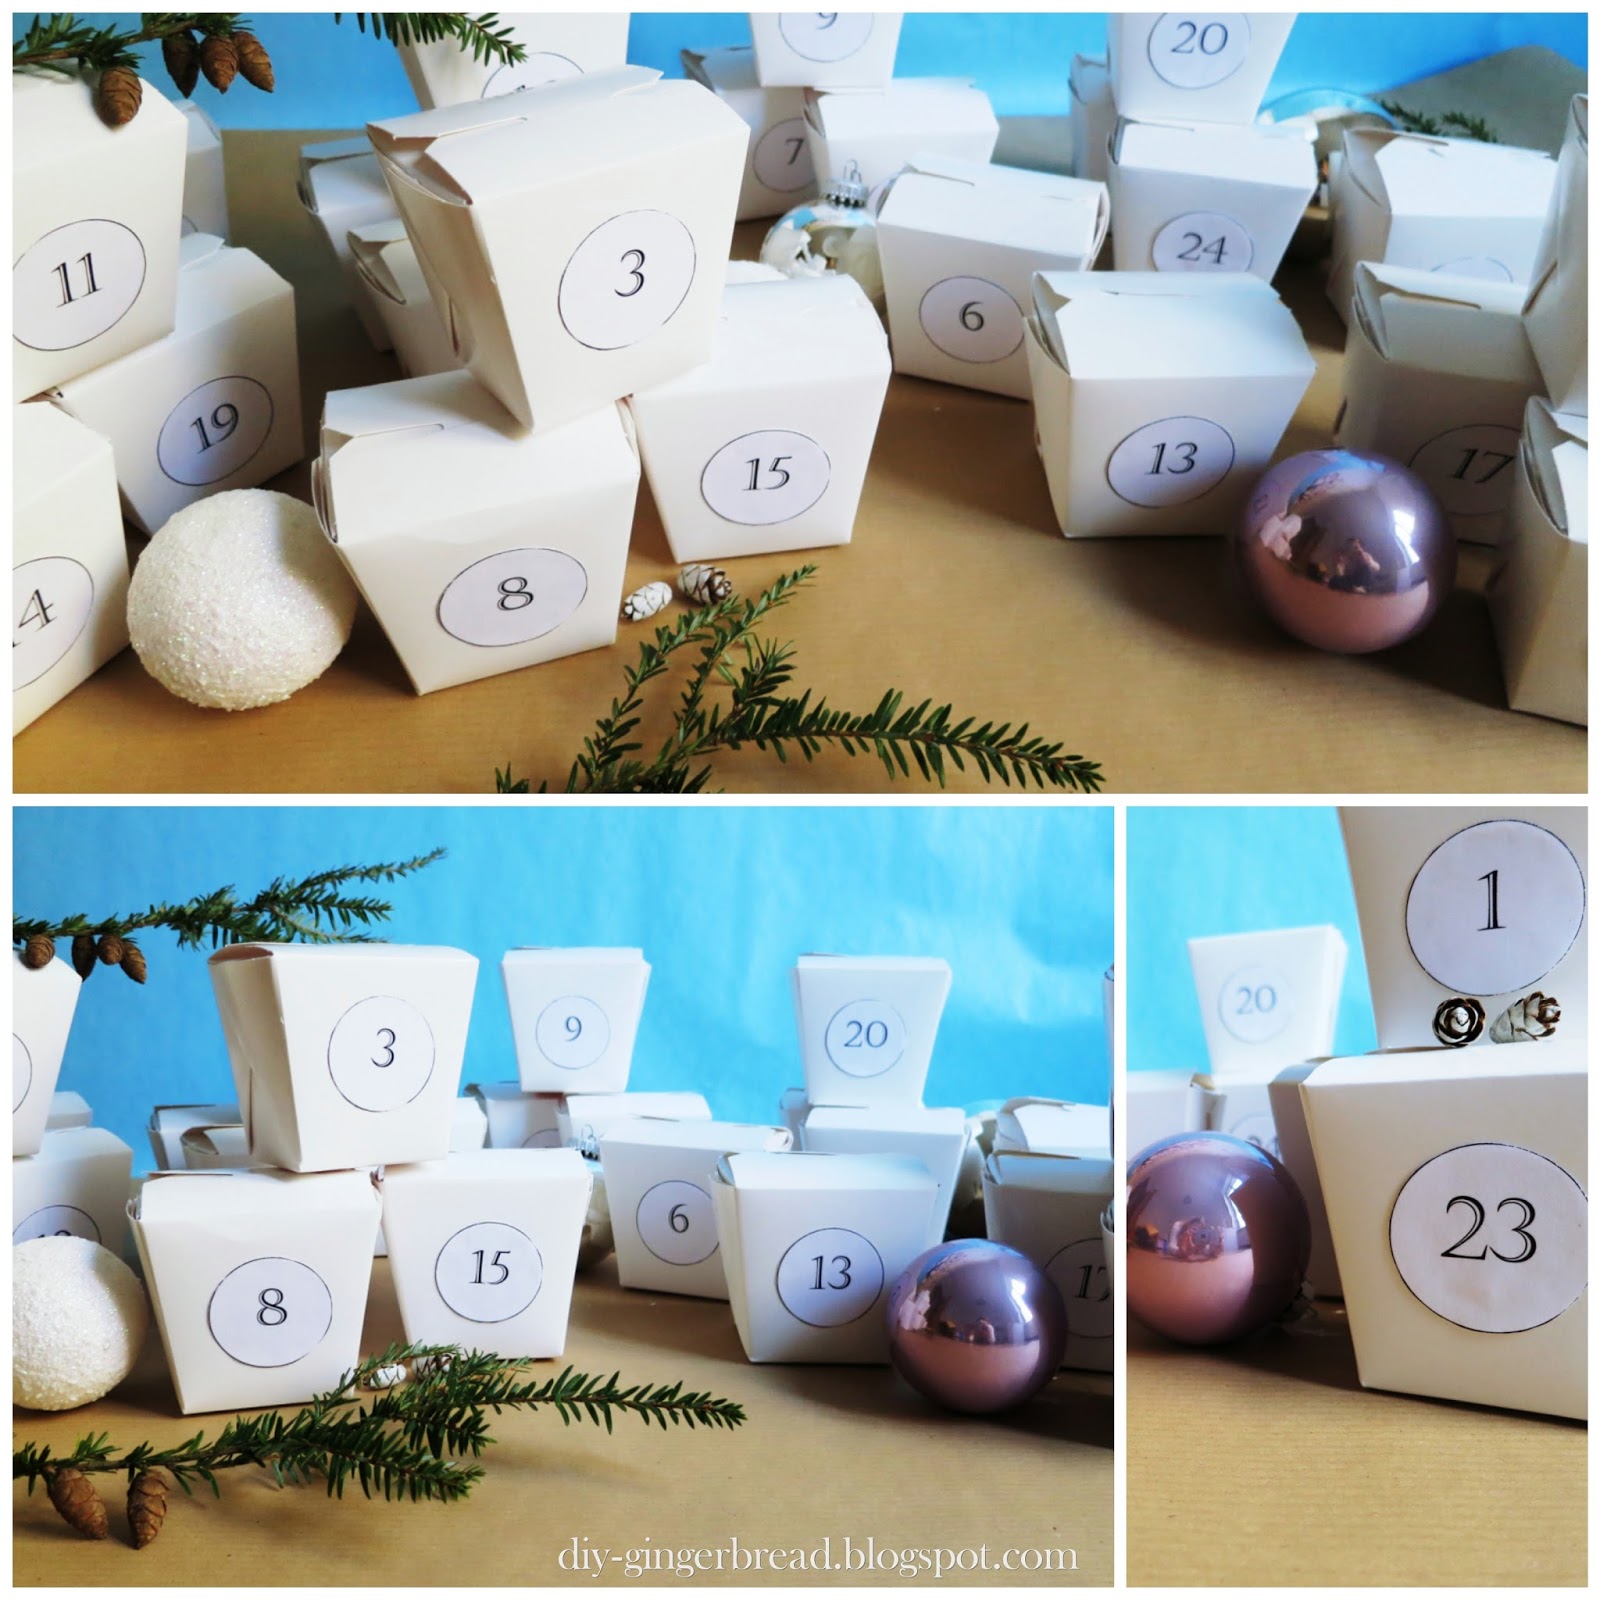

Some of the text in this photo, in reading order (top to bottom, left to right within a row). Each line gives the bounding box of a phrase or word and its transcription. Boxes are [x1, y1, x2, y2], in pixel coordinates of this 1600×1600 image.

[1170, 21, 1228, 56] 20
[785, 138, 804, 164] 7
[1176, 232, 1228, 264] 24
[51, 252, 103, 308] 11
[614, 249, 646, 297] 3
[959, 301, 984, 332] 6
[190, 402, 239, 455] 19
[743, 456, 792, 490] 15
[1148, 441, 1198, 474] 13
[1446, 447, 1515, 485] 17
[497, 576, 534, 611] 8
[1477, 869, 1505, 932] 1
[1236, 985, 1277, 1014] 20
[565, 1016, 583, 1042] 9
[843, 1020, 888, 1049] 20
[371, 1028, 397, 1068] 3
[667, 1204, 690, 1233] 6
[1440, 1195, 1538, 1263] 23
[469, 1249, 511, 1285] 15
[809, 1255, 852, 1290] 13
[256, 1288, 288, 1325] 8
